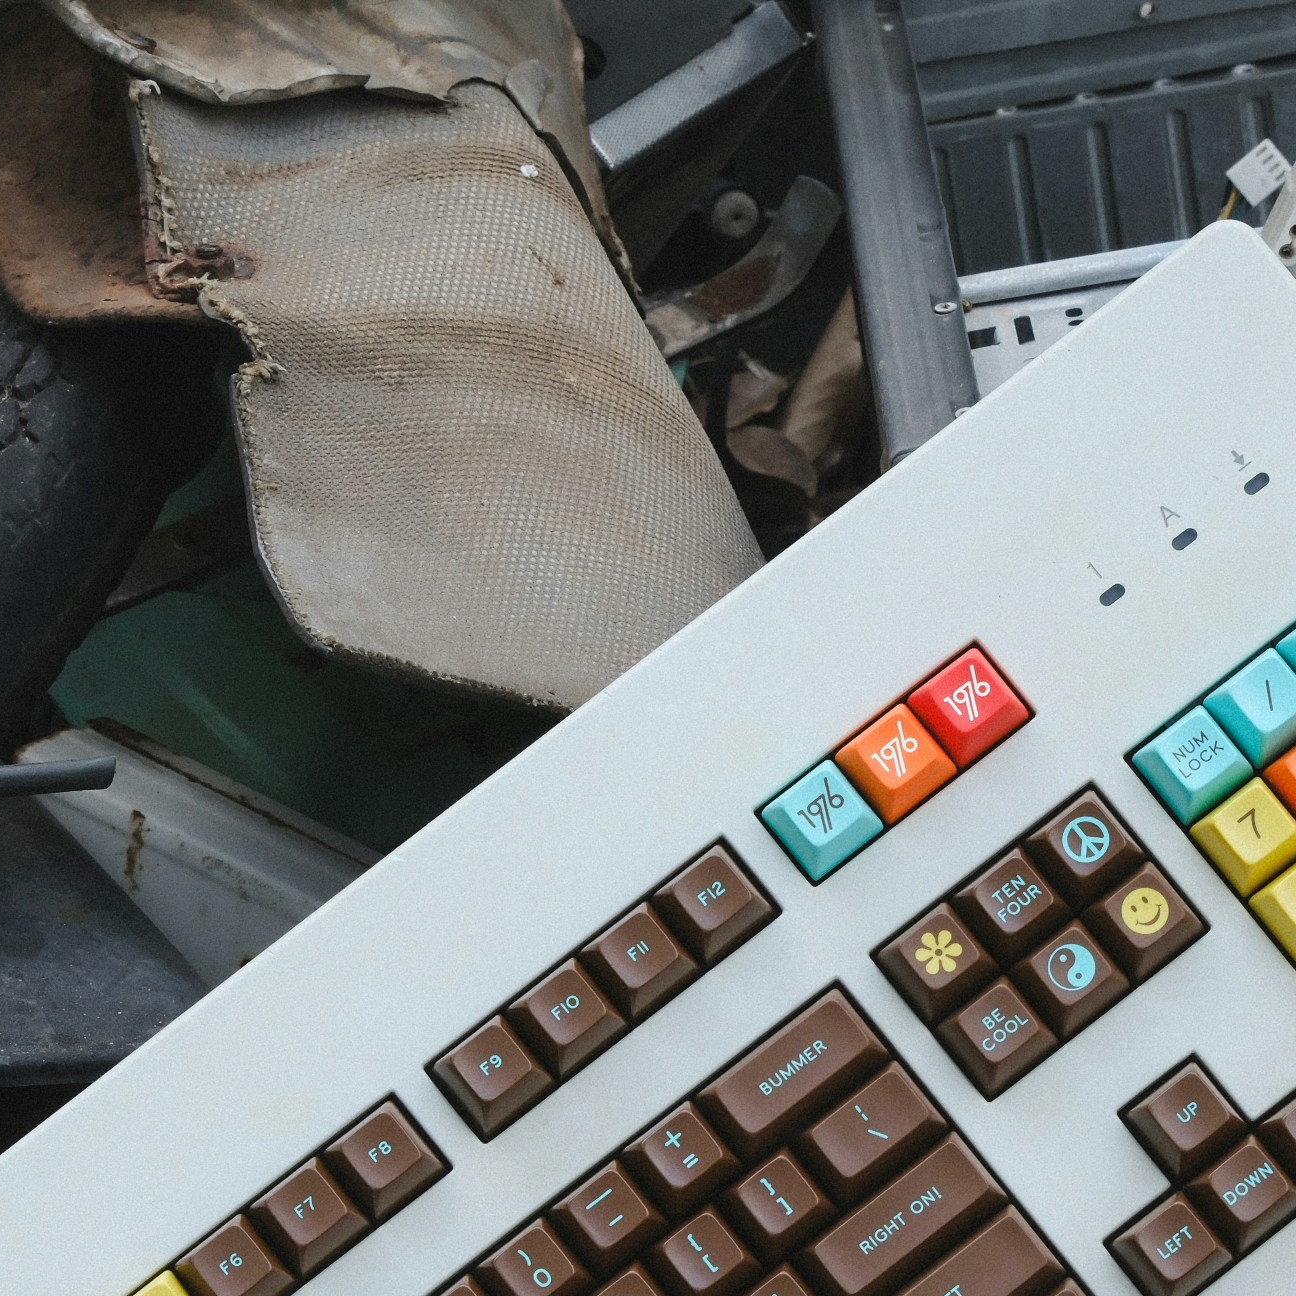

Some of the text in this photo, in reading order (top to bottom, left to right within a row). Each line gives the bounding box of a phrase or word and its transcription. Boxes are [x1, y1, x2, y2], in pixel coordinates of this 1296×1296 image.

[1160, 506, 1180, 528] A
[1087, 562, 1102, 579] 1
[1171, 731, 1210, 763] NUM
[1178, 738, 1225, 780] LOCK
[1237, 808, 1261, 838] 7
[697, 881, 725, 906] F12
[991, 873, 1026, 905] TEN
[997, 882, 1043, 924] FOUR
[627, 941, 649, 961] F11
[551, 995, 579, 1021] F10
[981, 1008, 1006, 1031] BE
[982, 1013, 1030, 1053] COOL
[480, 1055, 502, 1075] F9
[759, 1039, 828, 1096] BUMMER
[1177, 1102, 1197, 1122] UP
[368, 1141, 391, 1162] F8
[1222, 1161, 1275, 1208] DOWN
[294, 1196, 314, 1219] F7
[858, 1187, 942, 1256] RIGHT ON!
[1157, 1226, 1192, 1259] LEFT
[219, 1253, 242, 1275] F6
